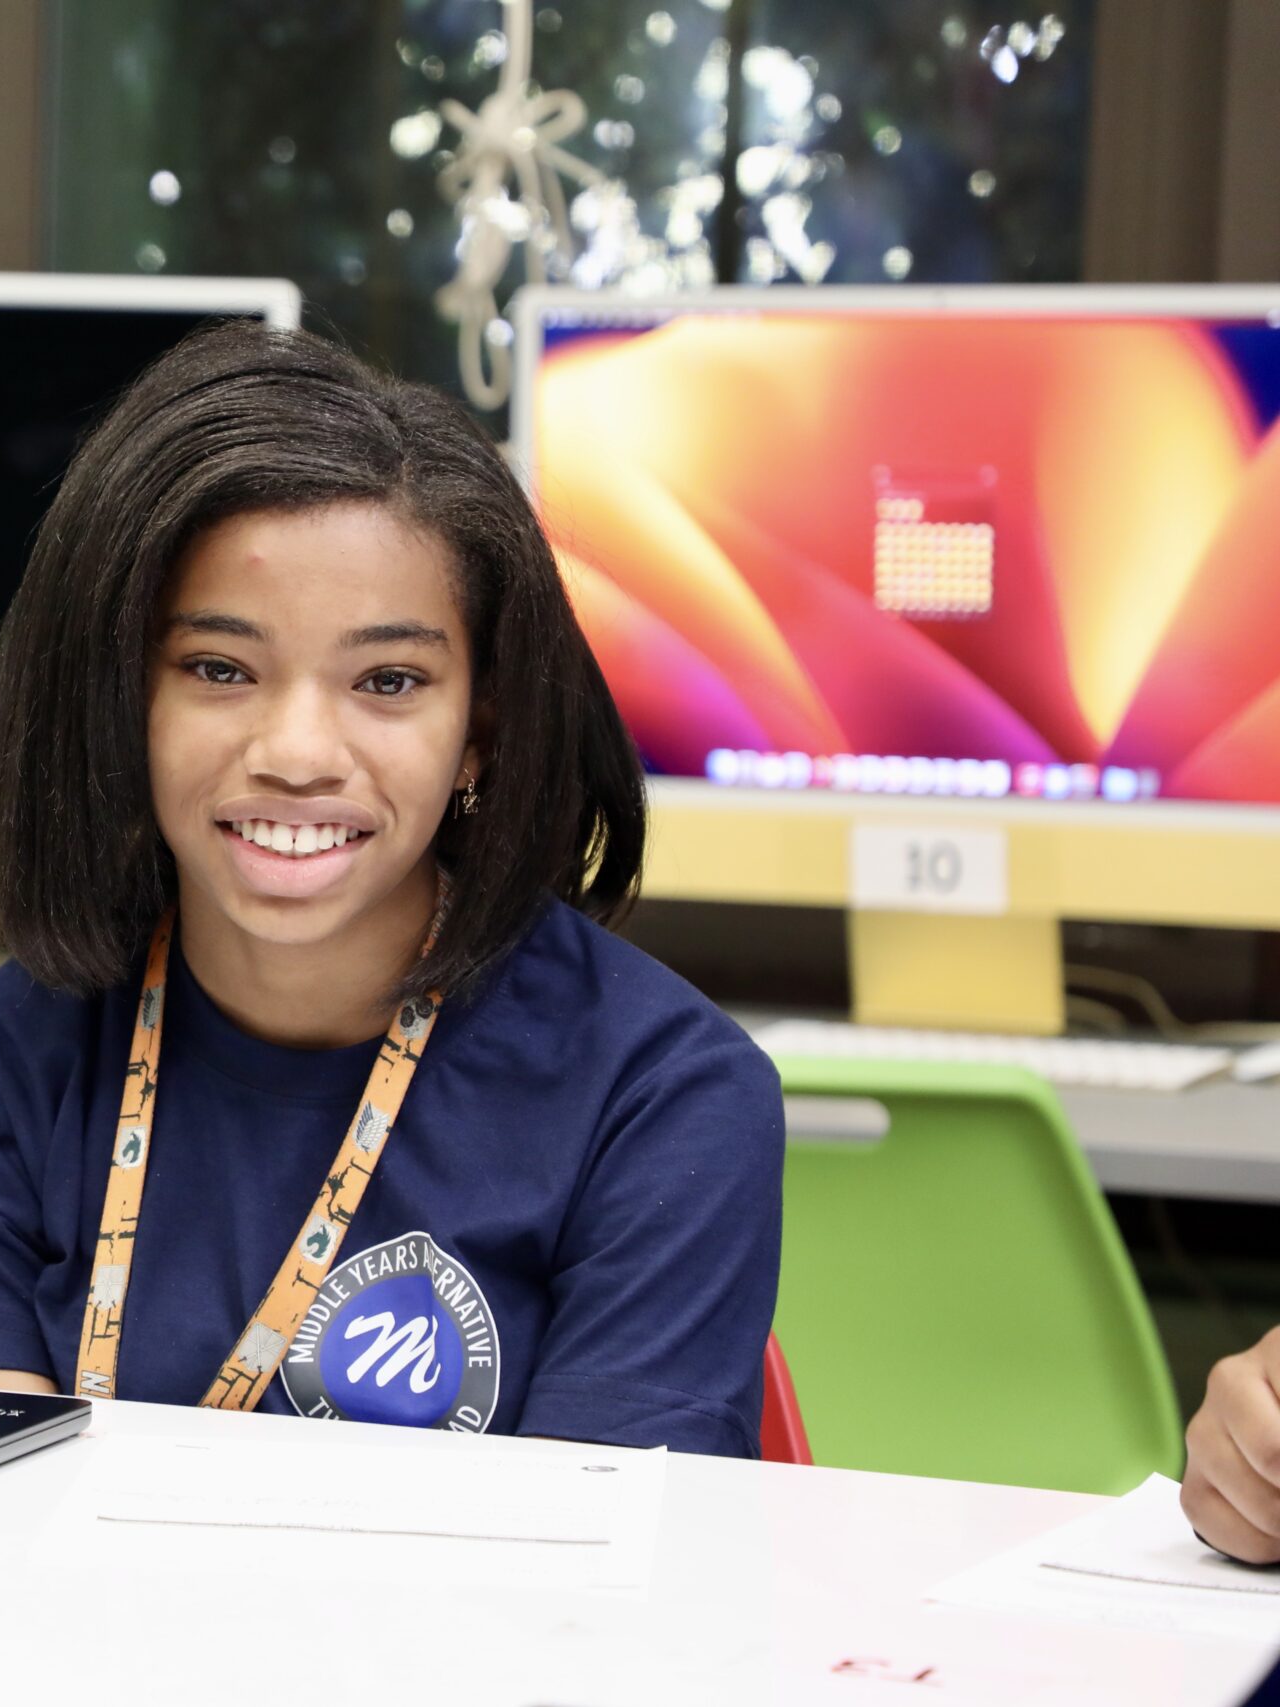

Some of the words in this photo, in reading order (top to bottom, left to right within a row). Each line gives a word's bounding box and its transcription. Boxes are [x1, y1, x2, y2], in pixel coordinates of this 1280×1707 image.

[904, 840, 964, 894] 10
[288, 1278, 350, 1364] MIDDLE
[348, 1240, 418, 1285] YEARS
